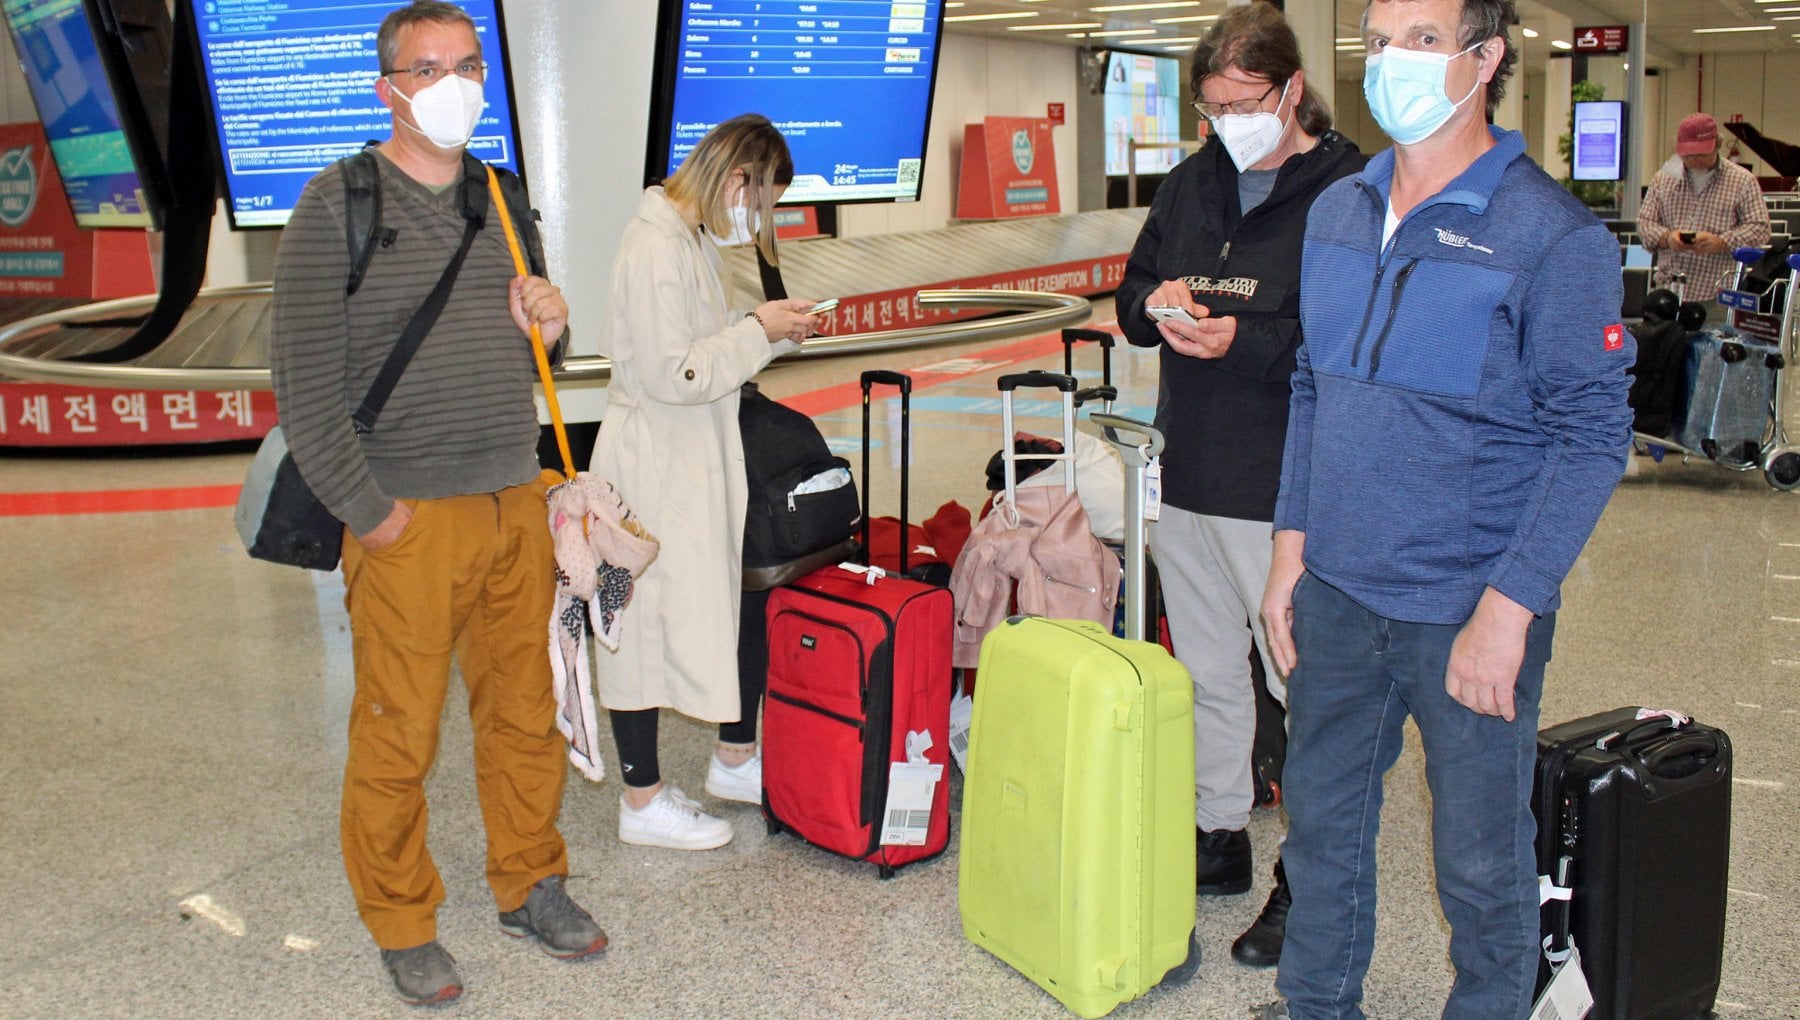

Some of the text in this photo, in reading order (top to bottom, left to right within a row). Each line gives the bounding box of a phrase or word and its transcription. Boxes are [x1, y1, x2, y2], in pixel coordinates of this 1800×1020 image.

[292, 54, 303, 62] any
[262, 62, 283, 71] amount
[834, 164, 846, 174] 24
[833, 176, 857, 186] 14:45
[253, 196, 272, 207] 1/7
[1017, 276, 1036, 291] VAT
[1038, 270, 1088, 292] EXEMPTION
